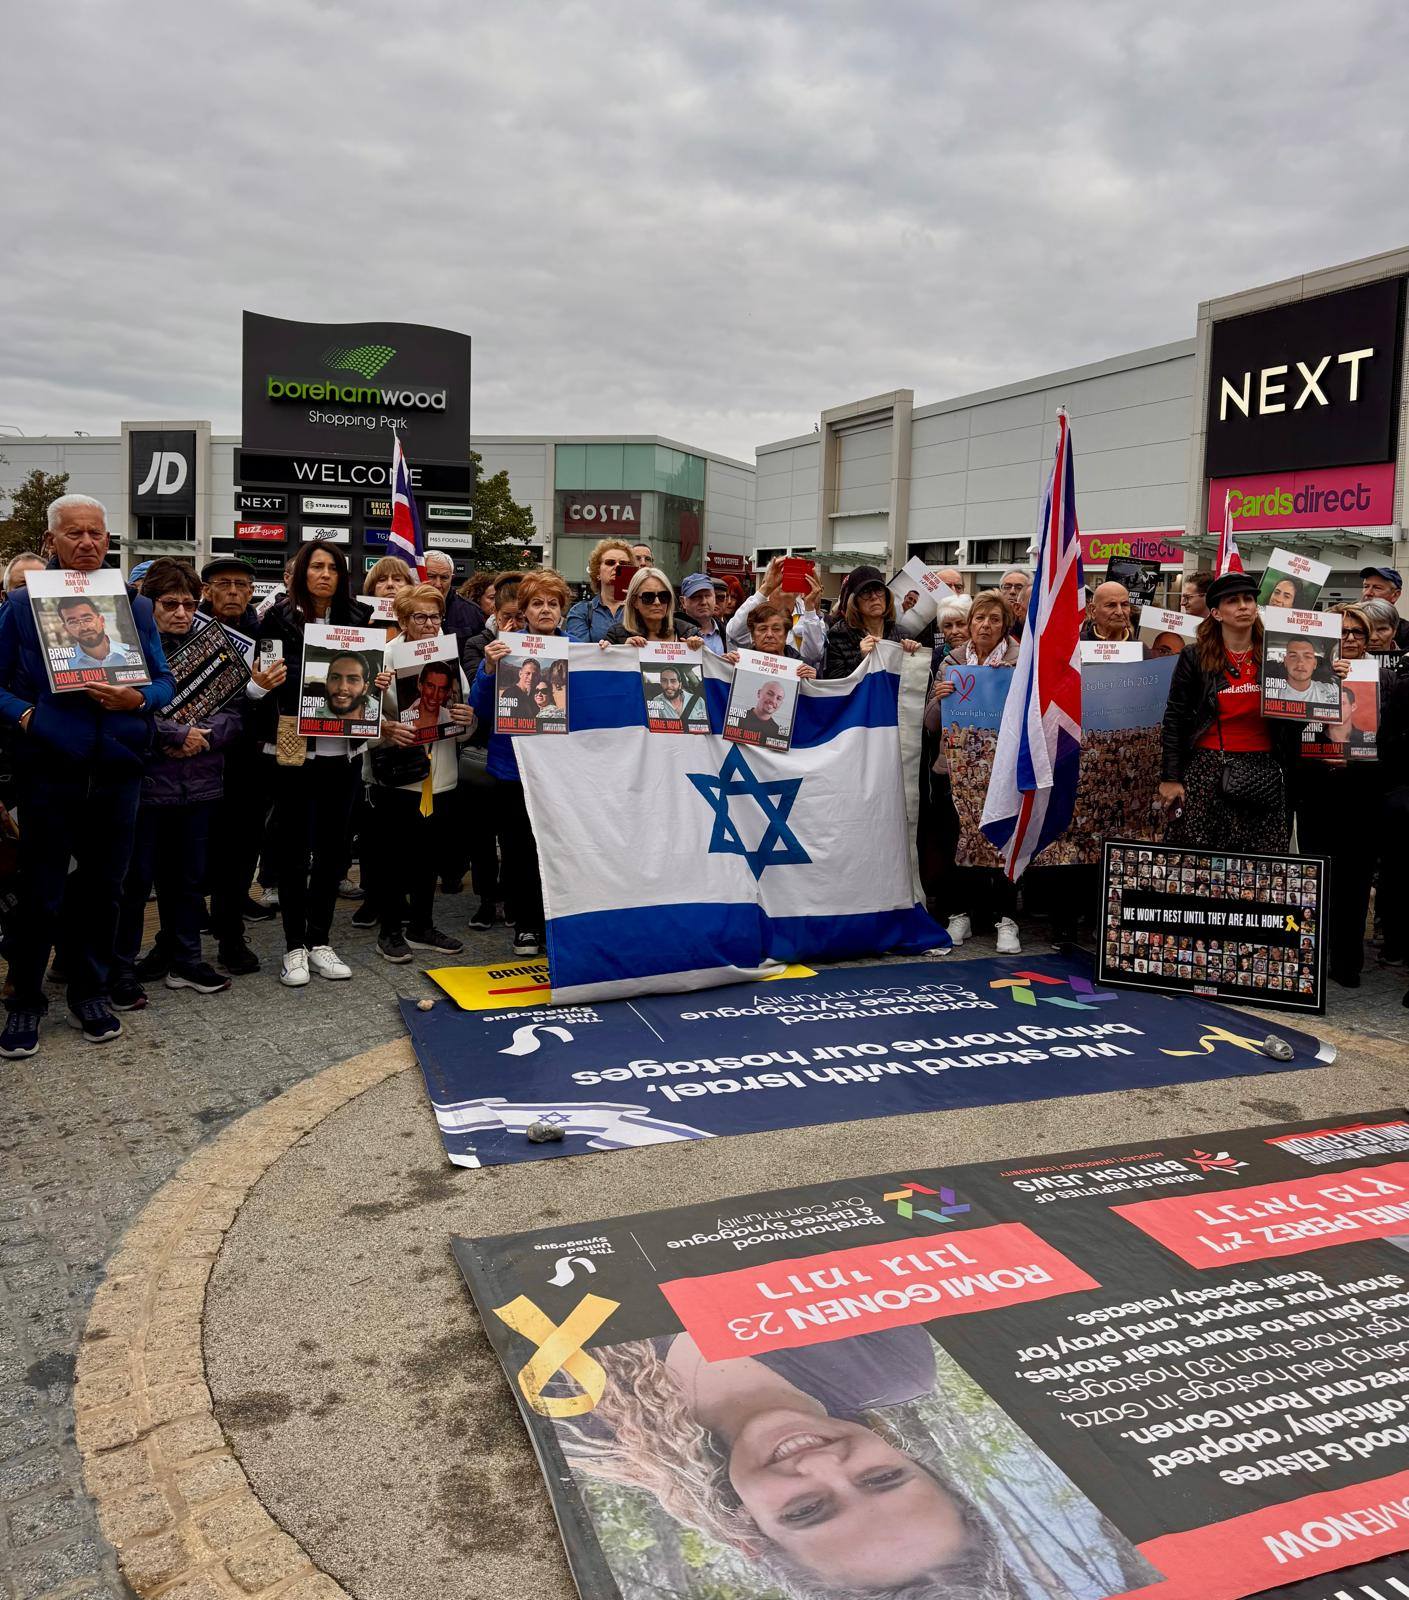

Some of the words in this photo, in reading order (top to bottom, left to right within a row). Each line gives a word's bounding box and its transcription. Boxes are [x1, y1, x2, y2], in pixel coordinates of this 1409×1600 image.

[267, 376, 446, 409] borehamwood
[1220, 347, 1374, 421] NEXT
[309, 410, 376, 429] Shopping
[380, 415, 408, 429] Park
[137, 451, 188, 495] JD
[241, 497, 282, 509] NEXT
[1227, 482, 1371, 518] Cardsdirect
[372, 508, 392, 516] BAGEL
[569, 504, 635, 522] COSTA
[238, 525, 262, 534] BUZZ
[261, 528, 283, 536] Bingo
[312, 528, 338, 540] Boots
[48, 647, 76, 660] BRING
[50, 660, 70, 671] HIM
[54, 671, 80, 684] HOME
[81, 668, 108, 681] NOW!
[1265, 677, 1287, 689] BRING
[181, 688, 191, 699] LAST
[302, 696, 325, 707] BRING
[498, 697, 518, 707] BRING
[1265, 688, 1280, 699] HIM
[301, 707, 316, 718] HIM
[400, 709, 420, 722] BRING
[498, 707, 511, 717] HIM
[729, 706, 747, 718] BRING
[969, 709, 986, 717] light
[1265, 700, 1285, 711] HOME
[1285, 701, 1307, 713] NOW!
[300, 719, 321, 731] HOME
[322, 720, 344, 732] NOW!
[498, 718, 517, 728] HOME
[517, 719, 537, 729] NOW!
[727, 716, 740, 727] HIM
[725, 727, 743, 738] HOME
[1301, 732, 1316, 742] HIM
[1123, 907, 1135, 920] WE
[1136, 908, 1162, 922] WON'T
[1163, 910, 1182, 923] REST
[1183, 911, 1206, 924] UNTIL
[1207, 912, 1227, 925] THEY
[1228, 913, 1245, 926] ARE
[1245, 914, 1259, 927] ALL
[1261, 914, 1284, 929] HOME
[487, 964, 549, 980] BRING
[753, 987, 911, 1005] Community
[917, 984, 964, 993] Our
[961, 991, 980, 1001] &
[680, 997, 857, 1021] Synagogue
[859, 993, 953, 1006] Elstree
[482, 1006, 593, 1022] Synagogue
[531, 1012, 599, 1023] United
[777, 1000, 999, 1026] Borehamwood
[1017, 1023, 1146, 1040] bring
[812, 1043, 890, 1060] our
[892, 1031, 1032, 1053] home
[1048, 1042, 1136, 1058] We
[571, 1050, 811, 1086] hostages
[807, 1059, 918, 1085] with
[913, 1049, 1050, 1075] stand
[646, 1070, 807, 1102] Israel,
[1273, 1134, 1352, 1154] FORUM
[1060, 1158, 1115, 1170] DEMOCRACY
[1118, 1151, 1165, 1163] ADVOCACY
[1000, 1166, 1054, 1177] COMMUNITY
[1088, 1159, 1190, 1182] BRITISH
[1154, 1173, 1205, 1185] BOARD
[1012, 1174, 1084, 1192] JEWS
[1055, 1182, 1133, 1199] DEPUTIES
[1135, 1180, 1154, 1189] OF
[827, 1196, 865, 1208] Our
[1034, 1193, 1055, 1204] OF
[1193, 1194, 1327, 1225] דניאל
[1317, 1177, 1405, 1203] פרץ
[717, 1204, 827, 1230] Community
[790, 1207, 855, 1228] Elstree
[863, 1206, 873, 1215] &
[1345, 1201, 1409, 1225] NIEL
[667, 1220, 787, 1249] Synagogue
[732, 1215, 886, 1251] Borehamwood
[1250, 1213, 1363, 1244] PEREZ
[533, 1236, 608, 1250] Synagogue
[567, 1242, 611, 1255] United
[589, 1248, 615, 1256] The
[757, 1267, 872, 1300] רומי
[879, 1243, 978, 1276] גונן
[940, 1264, 1054, 1299] ROMI
[1262, 1270, 1324, 1291] their
[1171, 1279, 1265, 1305] speedy
[1282, 1282, 1345, 1305] your
[1338, 1274, 1406, 1295] show
[785, 1283, 942, 1330] GONEN
[1067, 1296, 1175, 1326] release.
[1174, 1297, 1285, 1327] support,
[1319, 1298, 1378, 1322] join
[728, 1311, 784, 1342] 23
[1121, 1317, 1179, 1340] and
[1260, 1318, 1297, 1332] to
[1287, 1310, 1327, 1327] us
[1365, 1315, 1409, 1339] ngst
[1056, 1325, 1126, 1354] pray
[1184, 1324, 1264, 1348] share
[1291, 1327, 1363, 1351] more
[1016, 1343, 1060, 1363] for
[1121, 1338, 1192, 1364] their
[1226, 1342, 1297, 1363] than
[1015, 1354, 1122, 1383] stories,
[1184, 1355, 1236, 1377] 130
[1287, 1356, 1357, 1381] held
[1046, 1364, 1192, 1403] hostages.
[1176, 1369, 1298, 1401] hostage
[1305, 1379, 1367, 1404] and
[1145, 1394, 1184, 1410] in
[1226, 1391, 1312, 1424] Romi
[1060, 1402, 1149, 1428] Gaza,
[1284, 1398, 1407, 1436] officially
[1120, 1409, 1233, 1444] Gonen.
[1315, 1442, 1354, 1462] &
[1219, 1449, 1331, 1485] Elstree
[1262, 1497, 1409, 1564] MENOW
